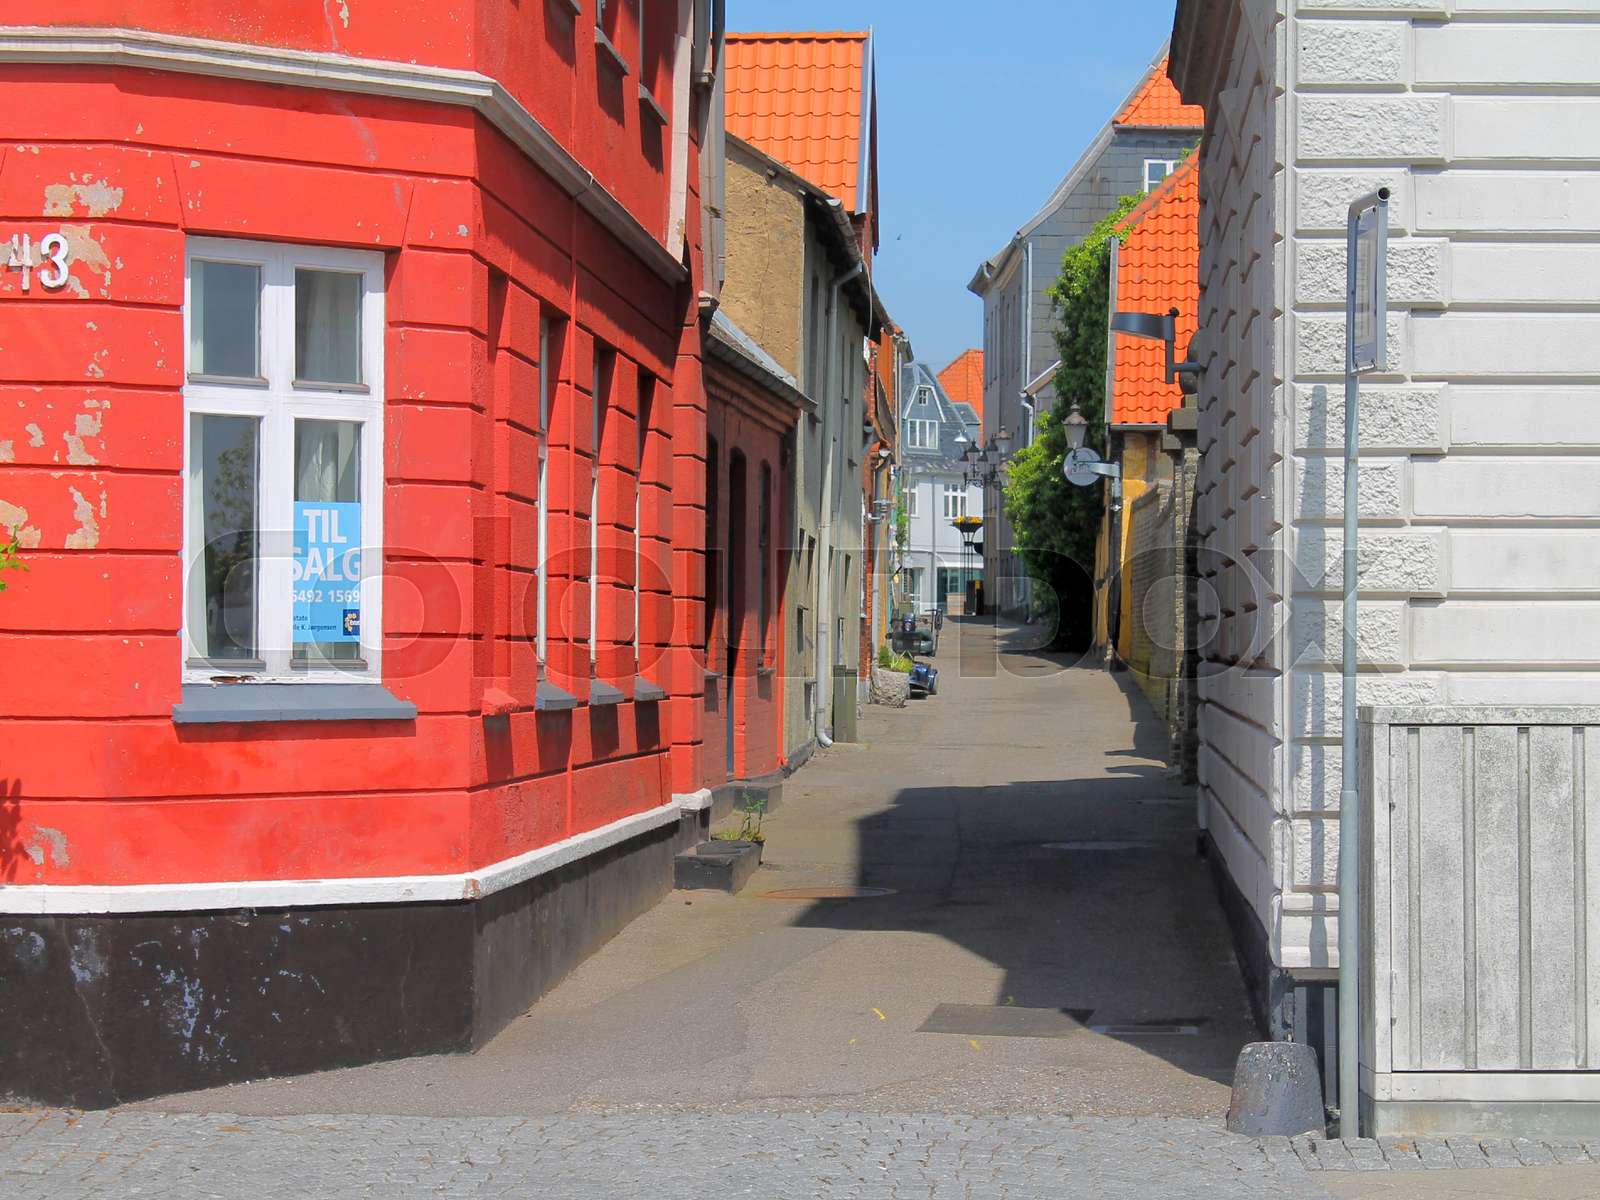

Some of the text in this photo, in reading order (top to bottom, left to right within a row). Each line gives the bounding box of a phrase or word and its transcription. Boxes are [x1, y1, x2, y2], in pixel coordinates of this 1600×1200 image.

[8, 233, 69, 290] 43
[303, 509, 347, 543] TIL
[293, 547, 360, 582] SALG
[328, 590, 360, 602] 1569
